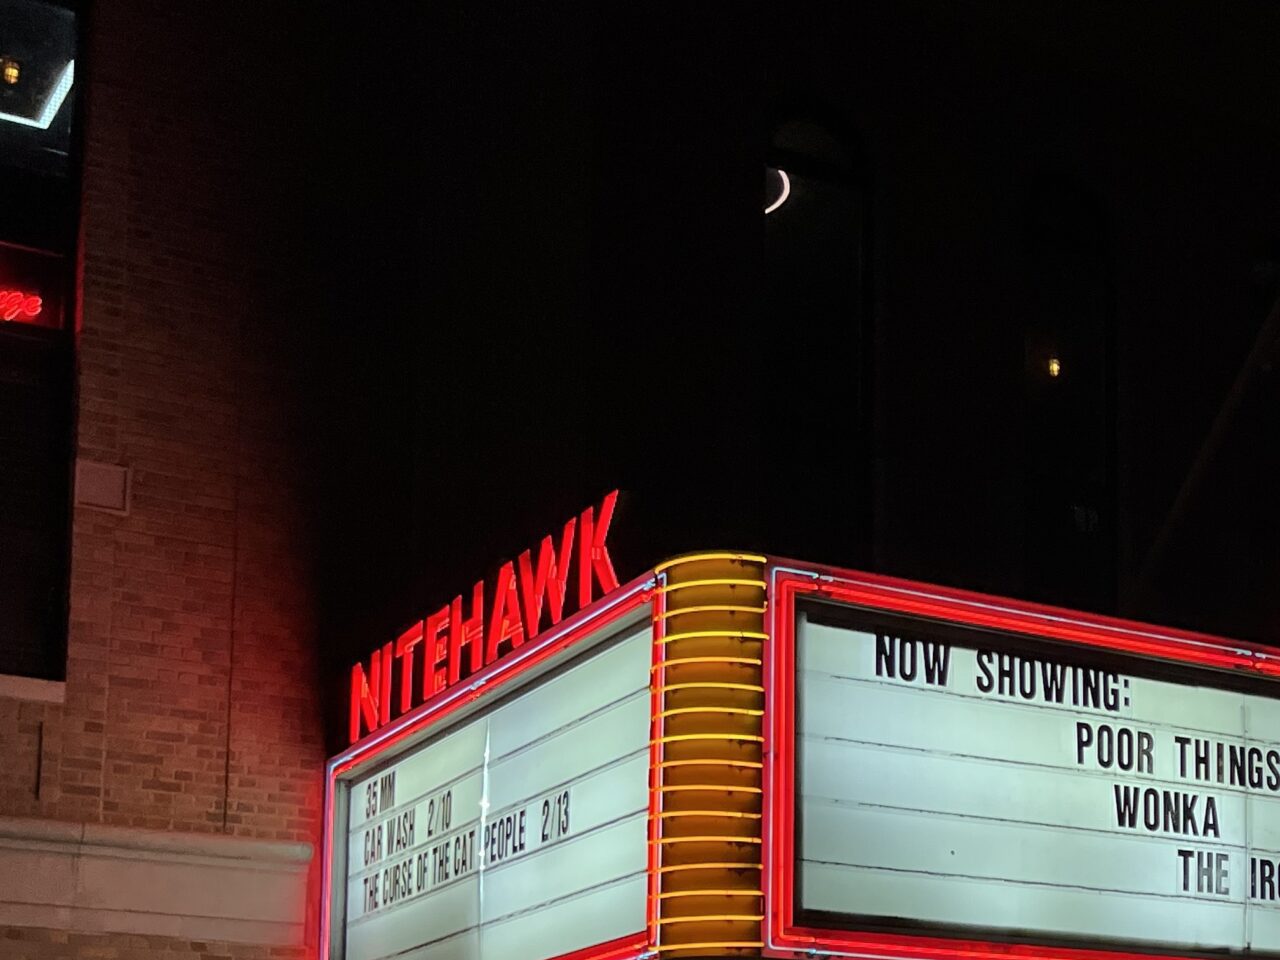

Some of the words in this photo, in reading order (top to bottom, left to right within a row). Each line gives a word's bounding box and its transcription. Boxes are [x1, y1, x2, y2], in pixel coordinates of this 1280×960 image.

[350, 489, 619, 743] NITEHAWK
[875, 634, 952, 687] NOW
[975, 649, 1130, 712] SHOWING:
[1076, 722, 1154, 774] POOR
[364, 825, 383, 866] CAR
[387, 808, 415, 857] WASH
[427, 790, 452, 837] 2/10
[1113, 784, 1220, 838] WONKA
[363, 872, 379, 913] THE
[382, 858, 413, 904] CURSE
[416, 851, 428, 892] OF
[432, 841, 450, 885] THE
[454, 831, 475, 876] CAT
[484, 810, 526, 863] PEOPLE
[541, 790, 570, 842] 2/13
[1177, 849, 1229, 895] THE
